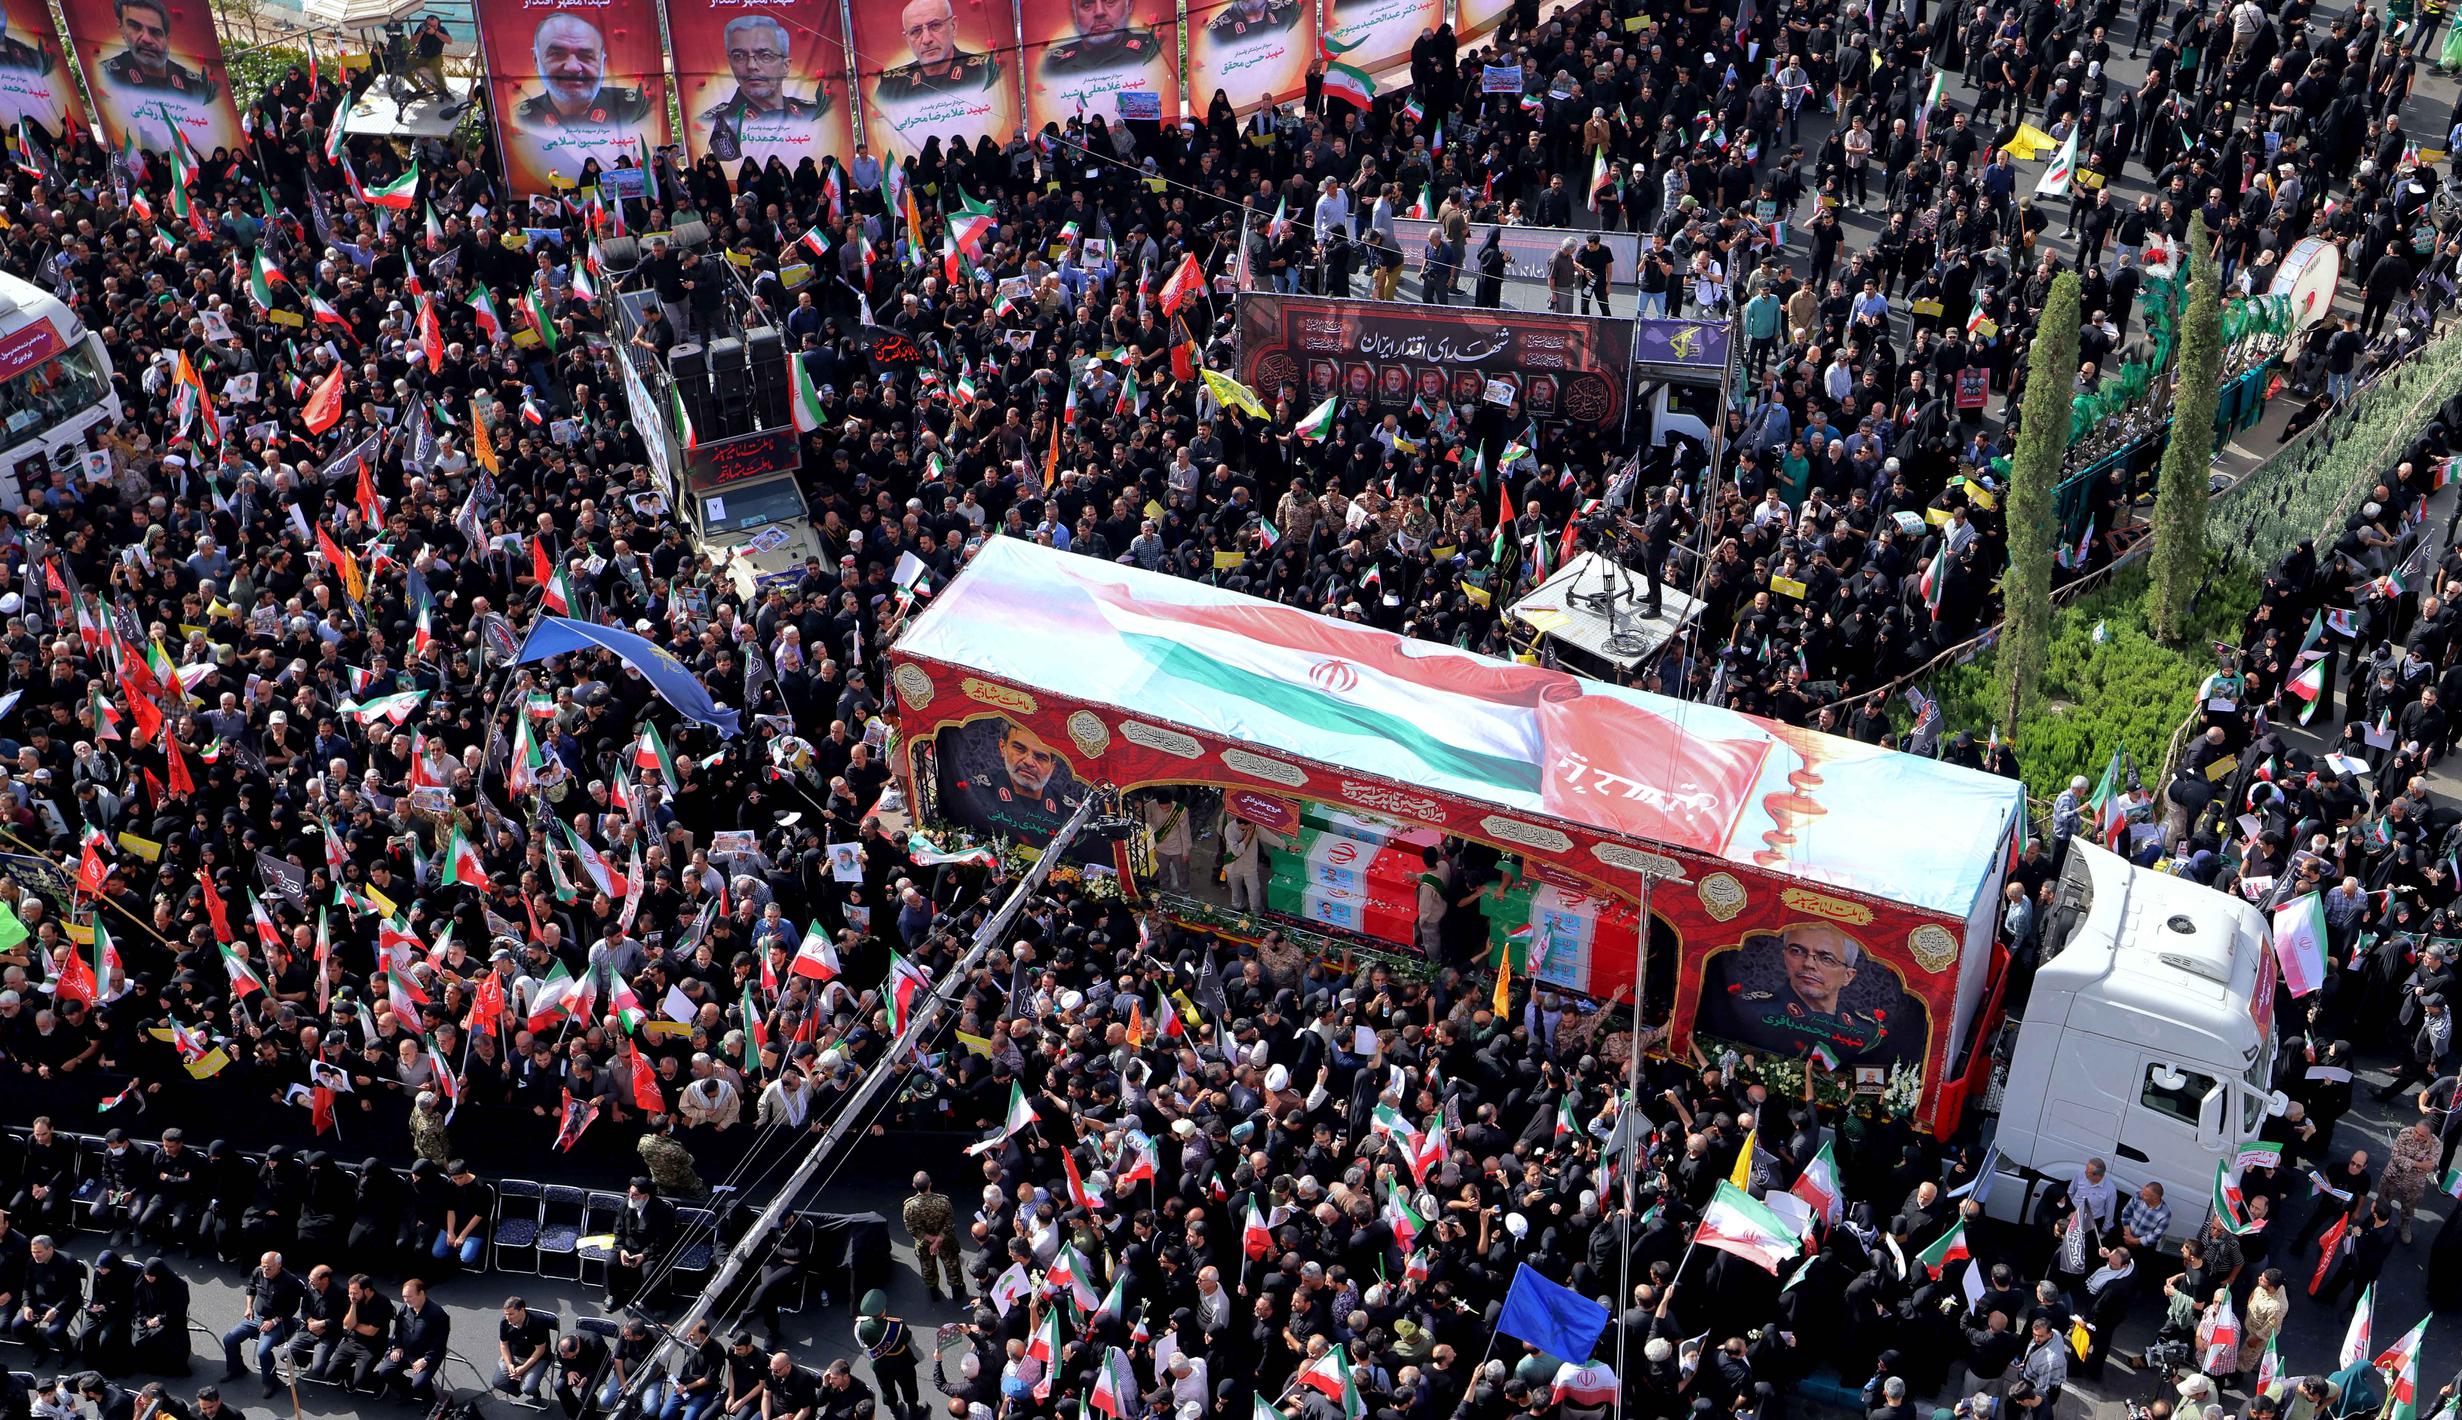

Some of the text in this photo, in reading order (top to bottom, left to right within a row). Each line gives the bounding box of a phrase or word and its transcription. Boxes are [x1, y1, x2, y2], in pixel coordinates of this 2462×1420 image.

[1401, 3, 1417, 19] دکتر
[1360, 11, 1401, 30] عبدالحمید
[1220, 46, 1286, 76] شهید حسن محقق
[2, 84, 50, 99] شهید محمد
[1060, 78, 1147, 100] شهید غلامعلی شید
[184, 115, 209, 128] شهید
[894, 103, 992, 132] شهید غلامرضا محرابی
[542, 136, 636, 151] شهید حسین سلامی
[754, 132, 785, 144] محمد
[784, 133, 812, 145] شهید
[1360, 329, 1395, 360] ایران
[971, 681, 1030, 711] ما ملت شهادتیم
[1389, 798, 1437, 813] حسین
[1417, 803, 1447, 824] ایران
[1017, 820, 1049, 835] مهدی
[1789, 890, 1820, 912] حسینیم
[1826, 902, 1858, 918] ملت
[1857, 910, 1865, 923] ما
[1760, 1014, 1865, 1048] شهید محمد باقری
